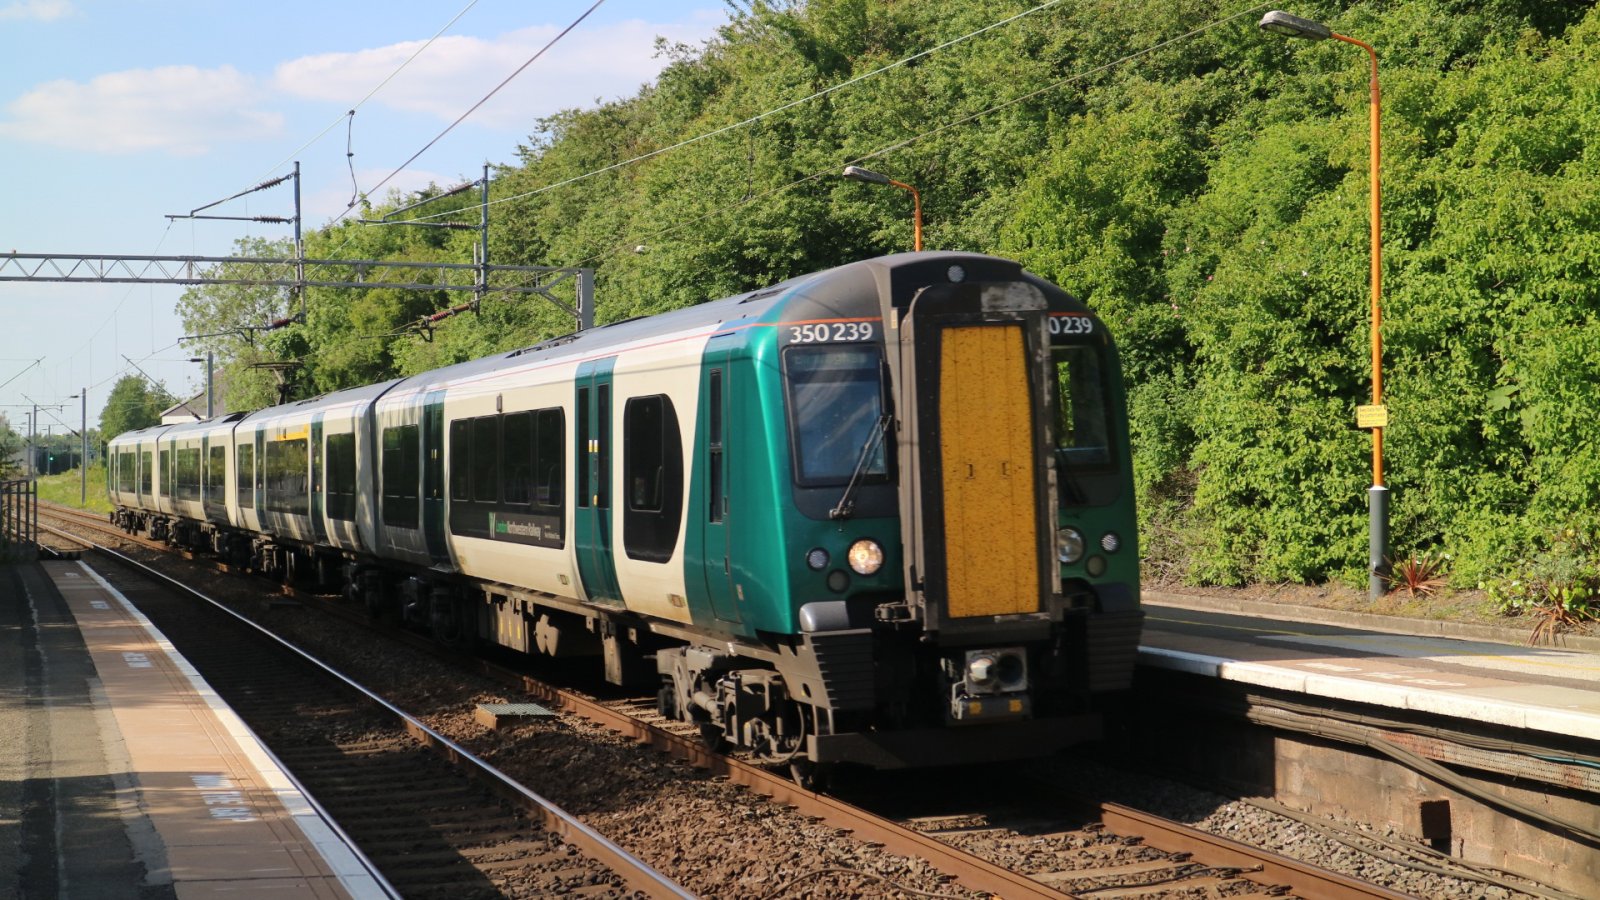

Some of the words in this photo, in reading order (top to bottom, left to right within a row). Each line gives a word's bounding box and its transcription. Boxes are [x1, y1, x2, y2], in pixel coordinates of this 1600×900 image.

[789, 323, 829, 343] 350
[832, 322, 873, 341] 239
[1060, 316, 1093, 334] 239
